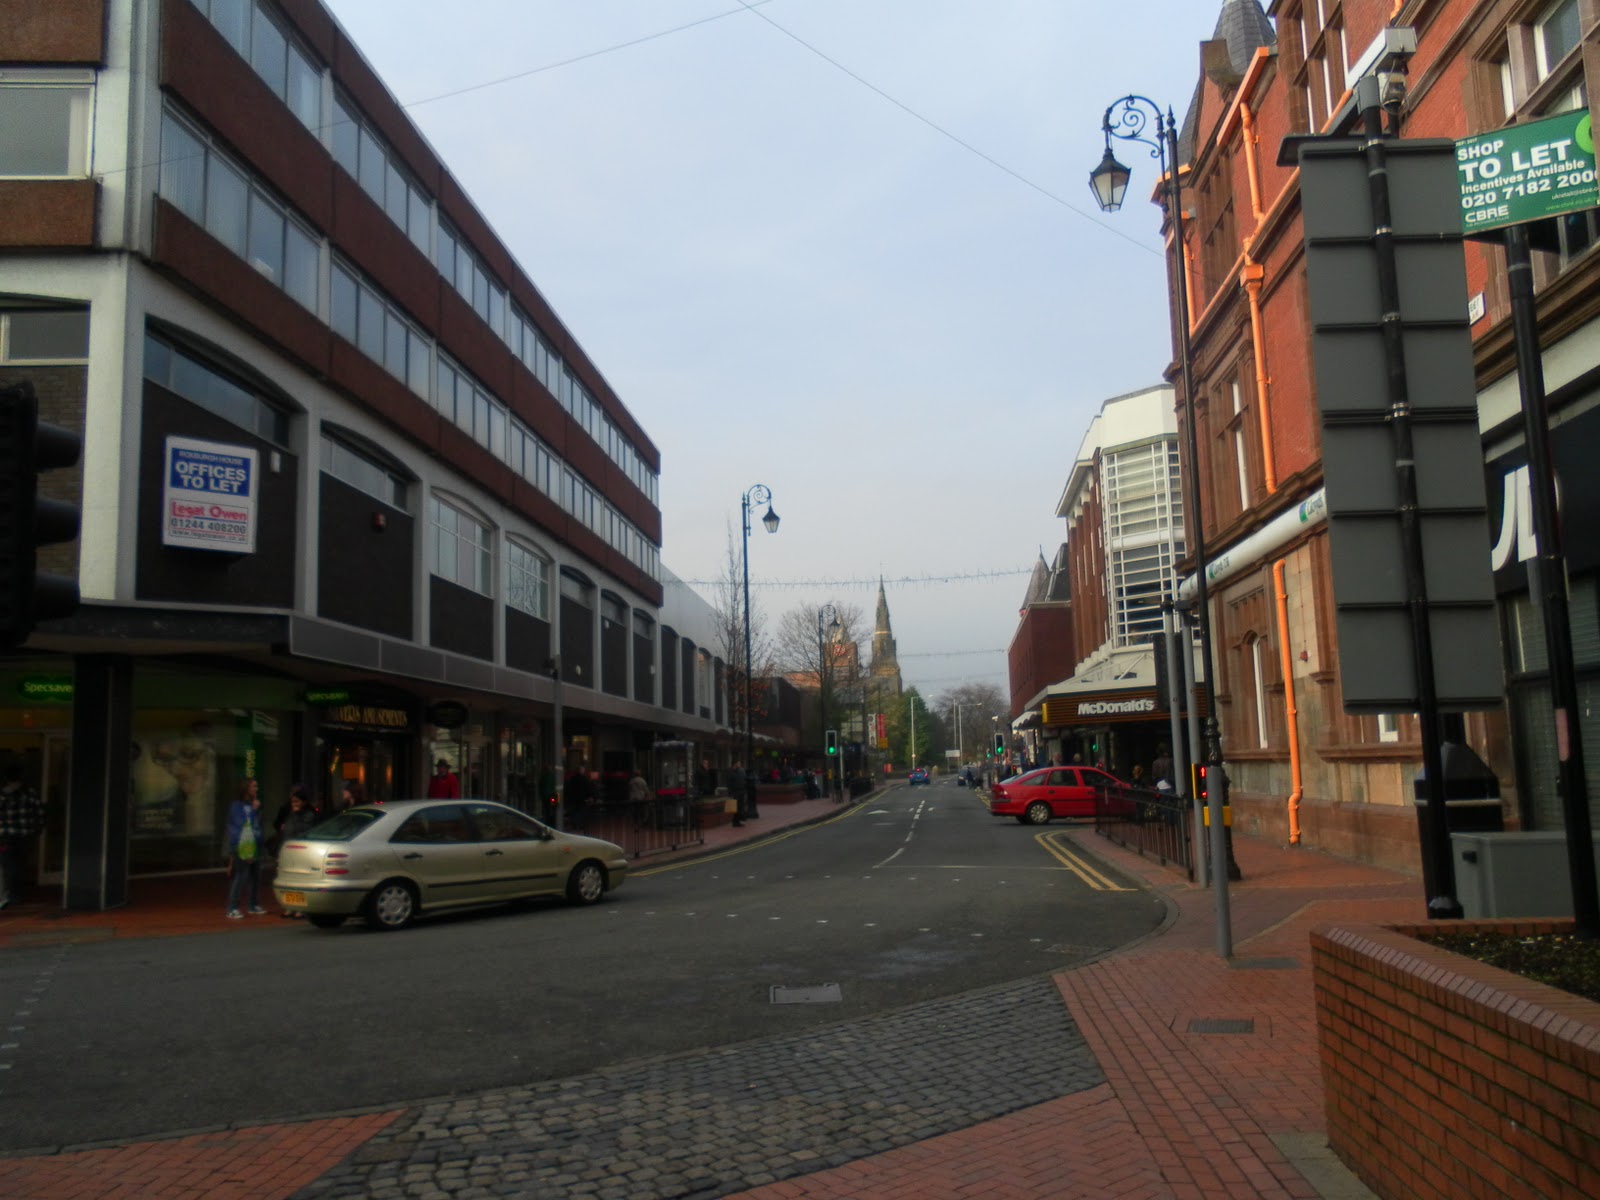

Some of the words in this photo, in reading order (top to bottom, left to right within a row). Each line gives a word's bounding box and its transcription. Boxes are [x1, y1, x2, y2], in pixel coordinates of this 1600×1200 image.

[1457, 139, 1504, 161] SHOP
[1458, 158, 1501, 183] TO
[1511, 138, 1572, 172] LET
[1461, 173, 1523, 195] Incentives
[1527, 159, 1585, 180] Available
[1461, 192, 1497, 209] 020
[1502, 179, 1551, 200] 7182
[1557, 170, 1598, 188] 200
[1464, 205, 1510, 223] CBRE
[175, 461, 247, 482] OFFICES
[180, 475, 205, 489] TO
[209, 478, 242, 493] LET
[209, 506, 247, 521] Owen
[171, 518, 205, 530] 01244
[208, 523, 246, 534] 408200
[1077, 698, 1155, 716] McDonald's
